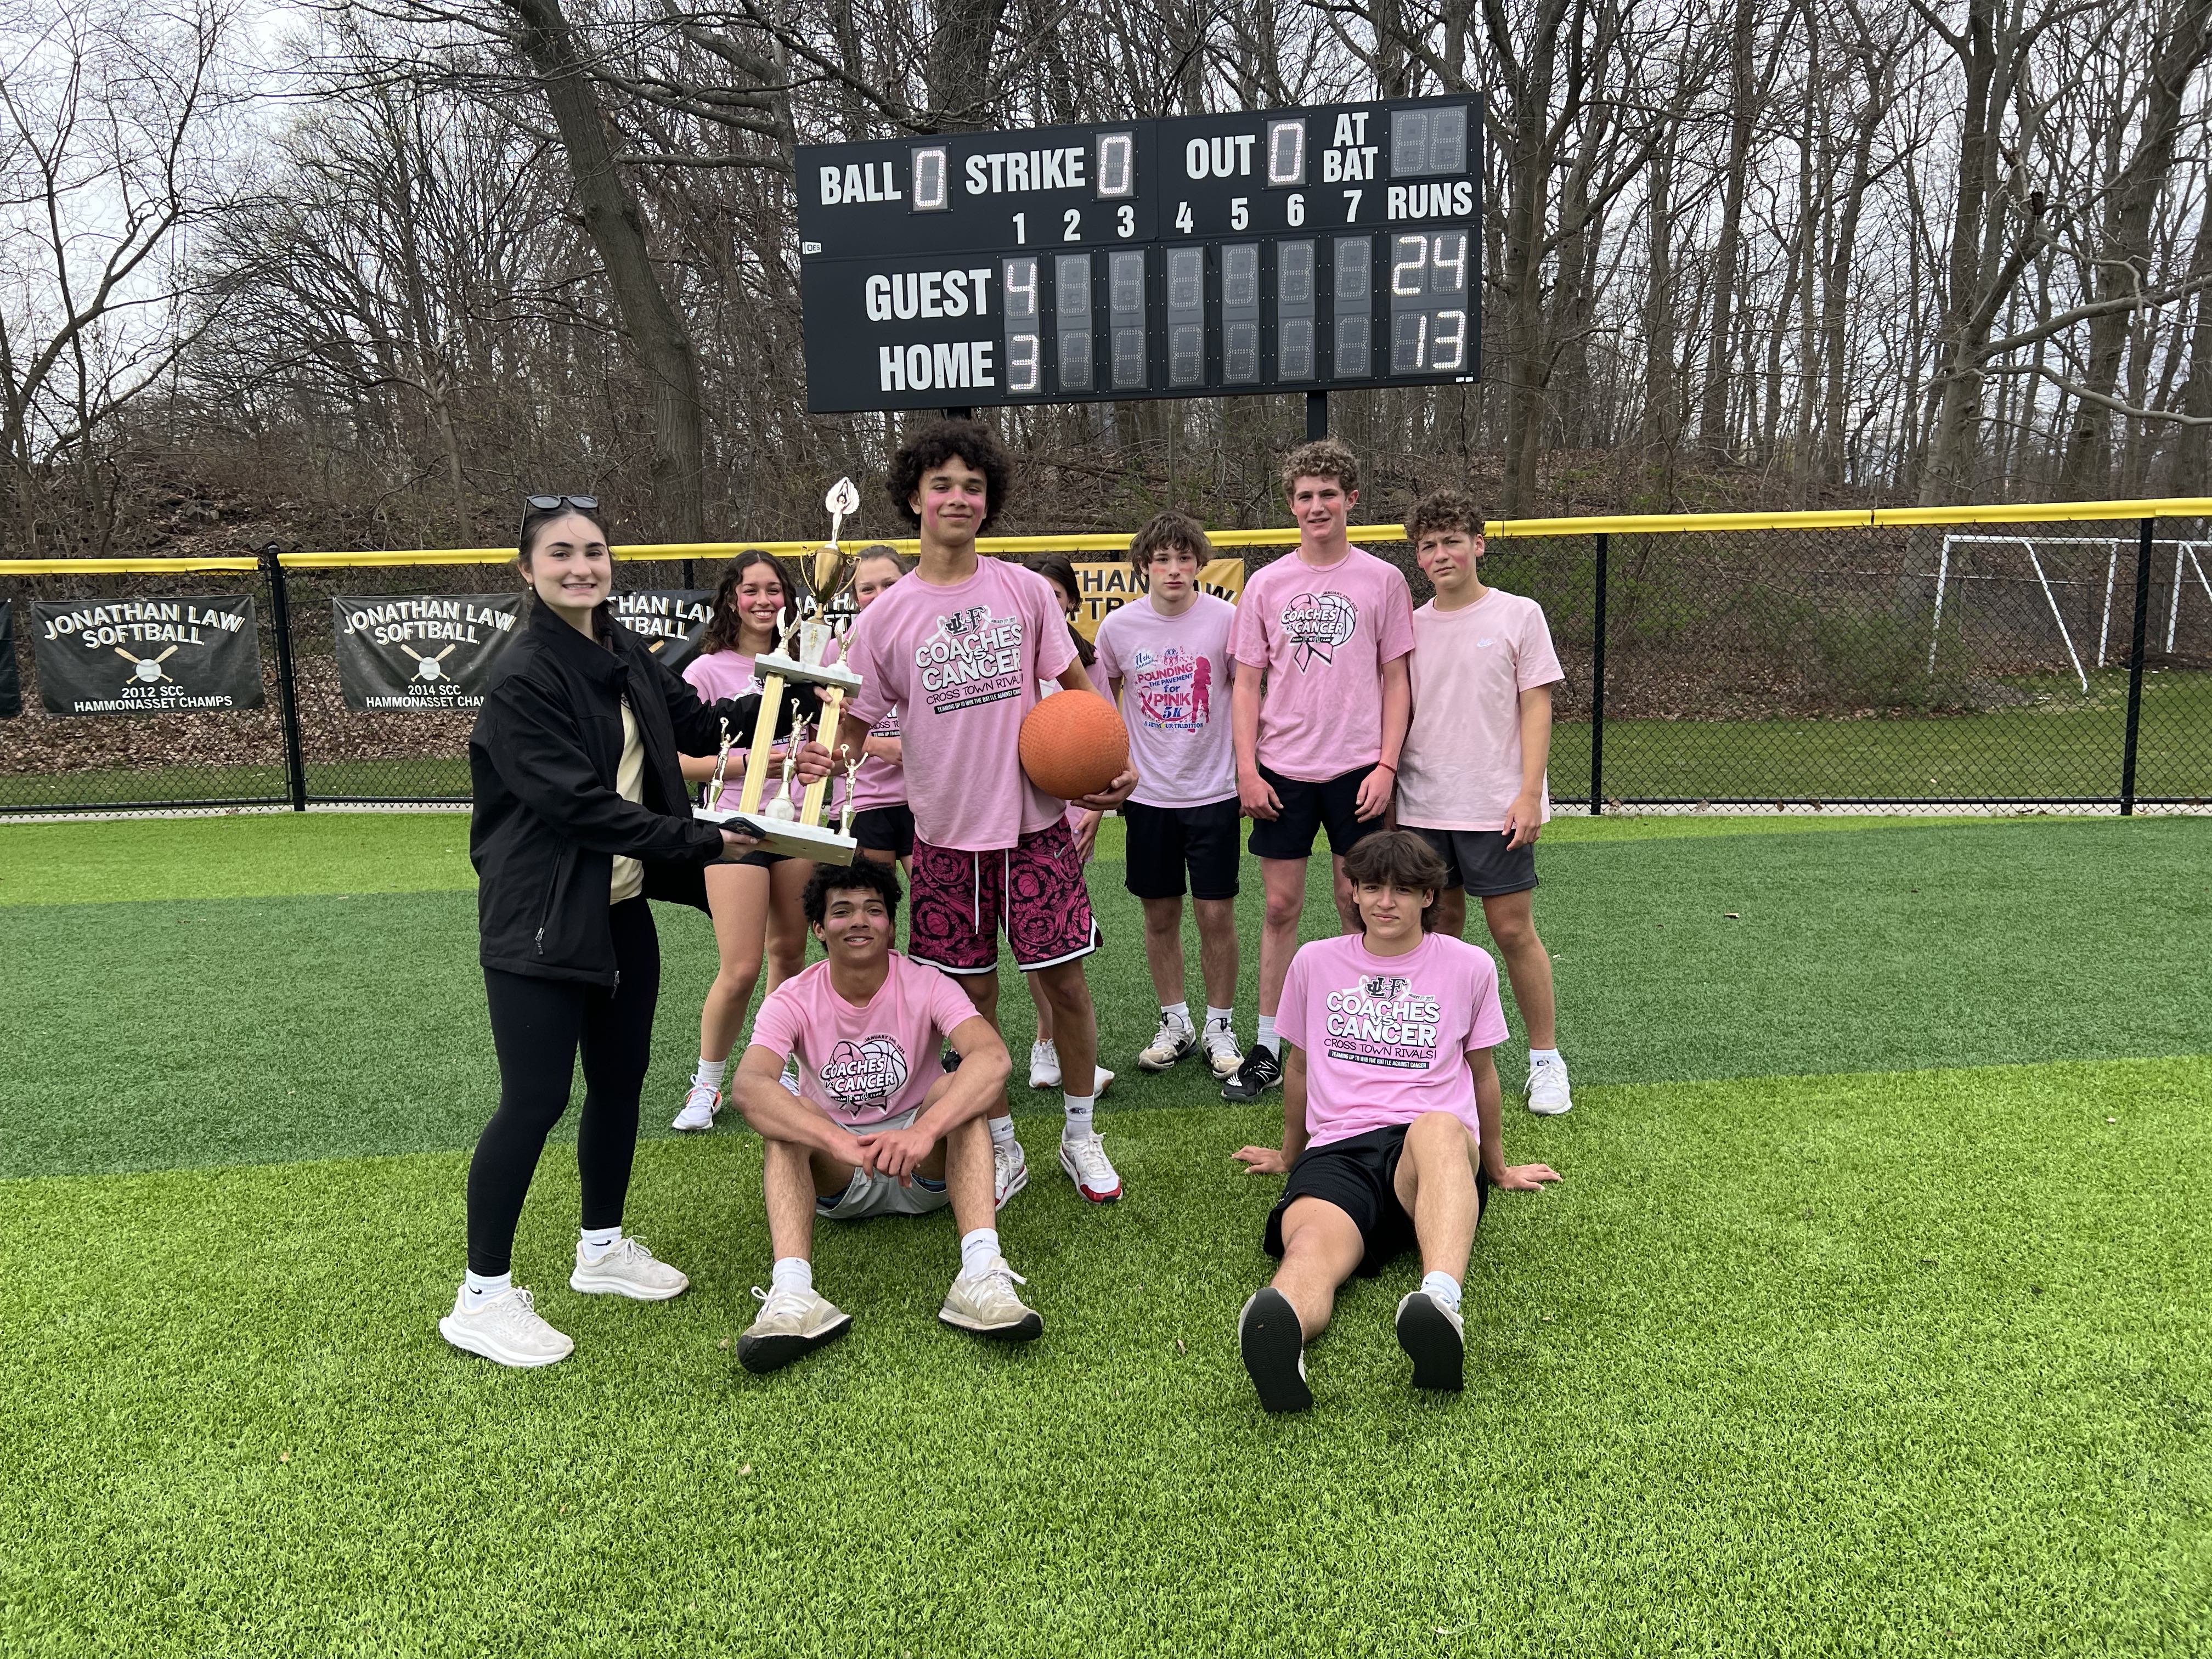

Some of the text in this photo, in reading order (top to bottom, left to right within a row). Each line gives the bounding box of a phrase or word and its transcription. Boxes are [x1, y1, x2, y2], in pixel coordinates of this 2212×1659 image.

[1333, 112, 1369, 147] AT
[966, 136, 1131, 195] STRIKE 0
[1186, 122, 1304, 183] OUT 0
[1323, 146, 1378, 183] BAT
[820, 149, 946, 207] BALL 0
[1012, 181, 1472, 244] 1 2 3 4 5 6 7 RUNS
[865, 235, 1466, 321] GUEST 4 24
[879, 310, 1466, 392] HOME 3 13
[44, 602, 246, 640] JONATHAN LAW
[343, 600, 517, 635] JONATHAN LAW
[1281, 608, 1338, 624] COACHES
[1295, 620, 1344, 635] CANCER
[82, 622, 205, 649] SOFTBALL
[374, 620, 481, 646] SOFTBALL
[915, 623, 1022, 668] COACHES
[922, 647, 1022, 692] CANCER
[1137, 663, 1193, 683] POUNDING
[1161, 673, 1193, 685] PAVEMENT
[121, 685, 184, 699] 2012 SCC
[408, 684, 461, 696] 2014 SCC
[926, 689, 960, 705] CROSS
[962, 679, 994, 696] TOWN
[982, 694, 997, 703] BATTLE
[997, 690, 1013, 699] AGAINST
[1153, 693, 1191, 707] PINK
[1164, 684, 1181, 693] for
[74, 695, 233, 712] HAMMONASSET CHAMPS
[366, 696, 454, 708] HAMMONASSET
[1326, 991, 1441, 1024] COACHES
[1326, 1013, 1437, 1048] CANCER
[1324, 1039, 1437, 1060] CROSS TOWN RIVALS!
[821, 1057, 886, 1081] COACHES
[834, 1072, 896, 1093] CANCER
